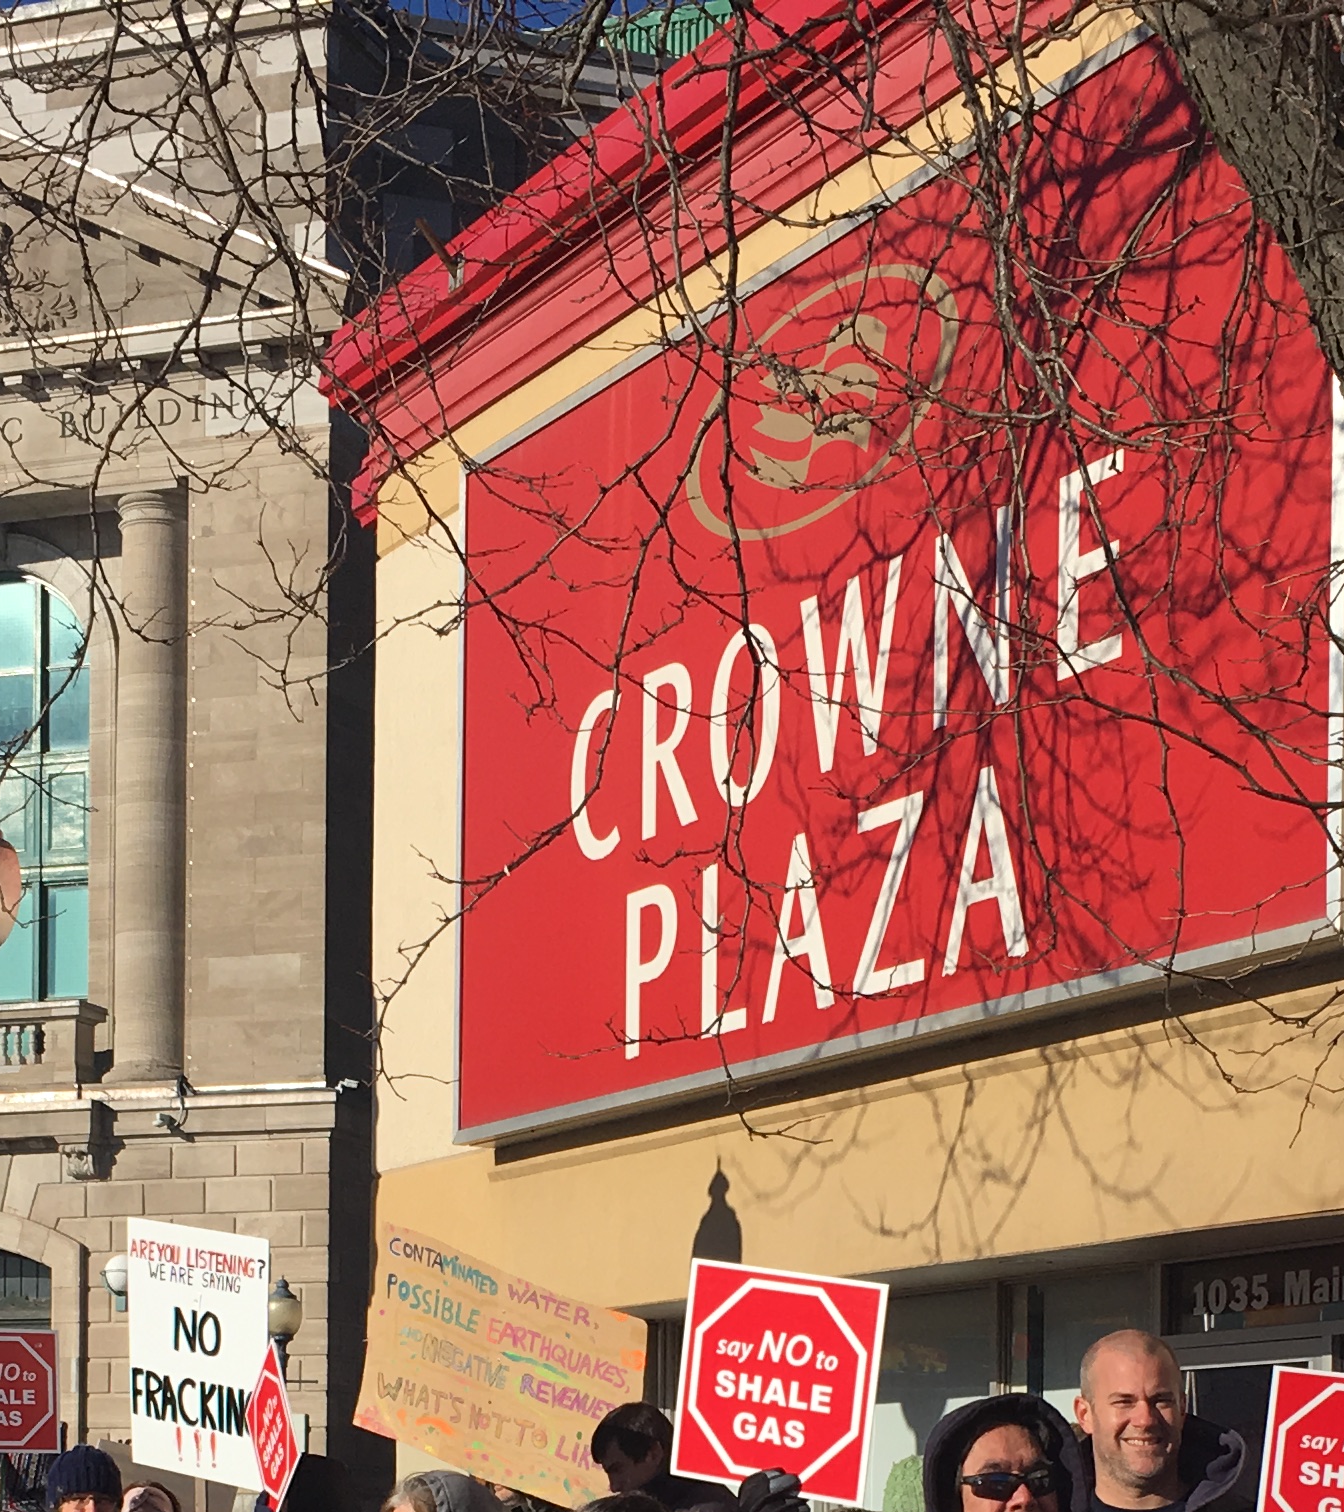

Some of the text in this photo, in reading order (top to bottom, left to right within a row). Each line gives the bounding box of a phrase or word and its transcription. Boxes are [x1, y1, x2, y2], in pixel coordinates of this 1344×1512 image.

[570, 448, 1124, 861] CROWNE
[625, 765, 1027, 1058] PLAZA
[130, 1238, 266, 1279] ARE YOU LISTENING?
[148, 1261, 241, 1294] WE ARE SAYING
[1193, 1274, 1269, 1316] 1035
[173, 1306, 221, 1356] NO
[716, 1330, 838, 1371] say NO to
[23, 1370, 36, 1381] to
[715, 1370, 833, 1414] SHALE
[131, 1367, 253, 1437] FRACKIN
[377, 1372, 464, 1423] WHAT'S
[515, 1418, 548, 1449] TO
[263, 1412, 284, 1468] SHALE
[733, 1412, 805, 1448] GAS
[1299, 1434, 1338, 1455] say
[271, 1443, 284, 1480] GAS
